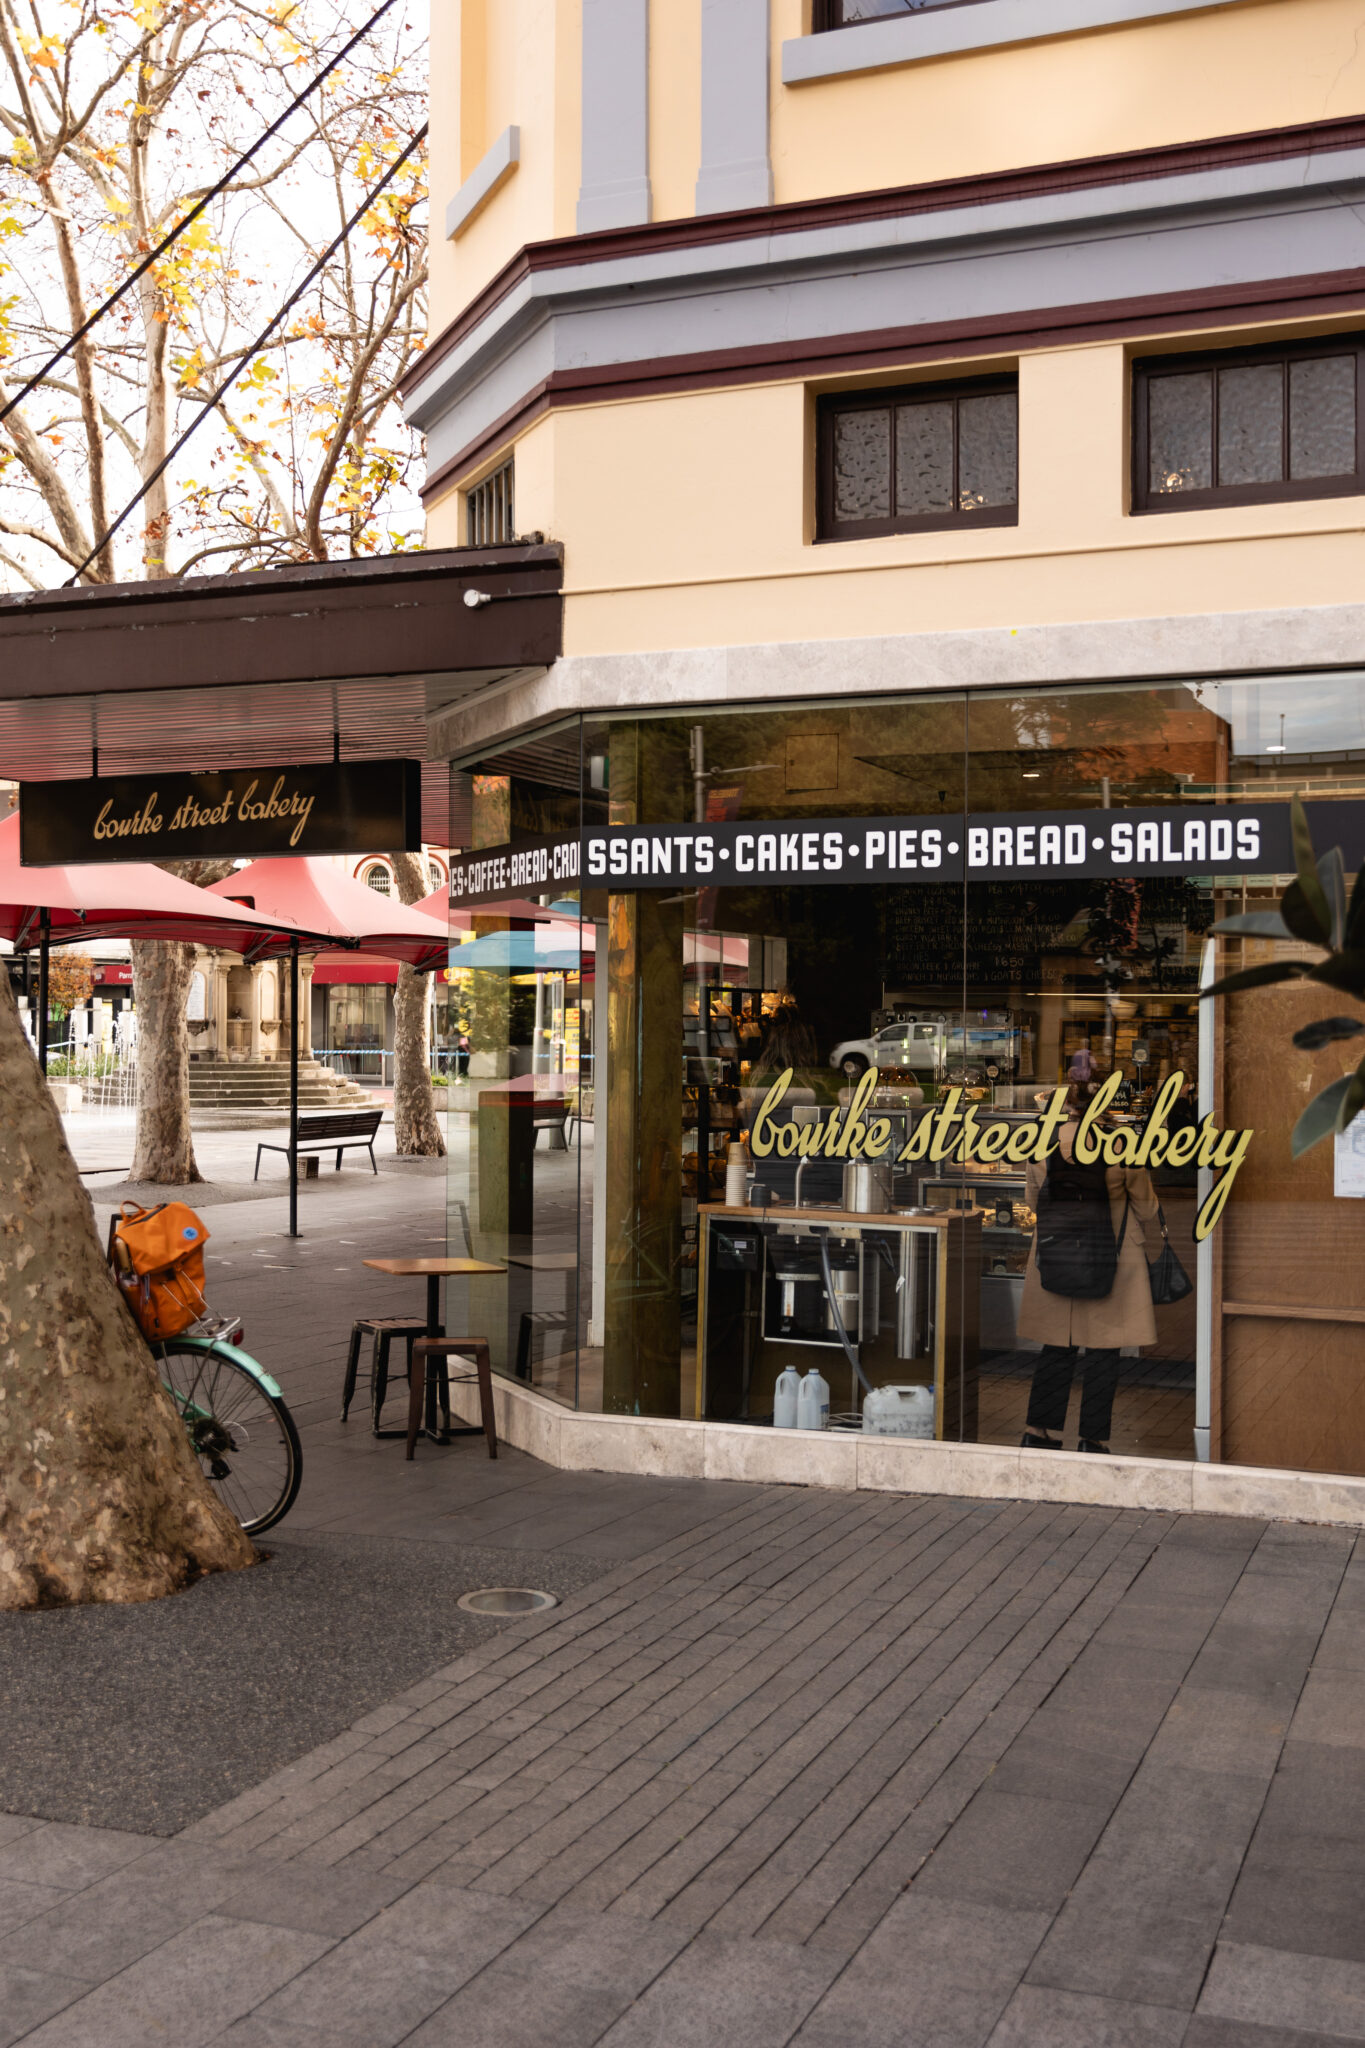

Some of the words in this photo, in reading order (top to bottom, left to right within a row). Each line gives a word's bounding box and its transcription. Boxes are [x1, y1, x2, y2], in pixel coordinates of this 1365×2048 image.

[94, 792, 163, 840] bourke
[168, 790, 234, 831] street
[238, 775, 315, 847] bakery
[468, 857, 506, 894] COFFEE
[511, 848, 548, 887] BREAD
[588, 835, 713, 876] SSANTS
[735, 831, 842, 873] CAKES
[865, 829, 942, 870] PIES
[968, 824, 1086, 867] BREAD
[1110, 818, 1260, 864] SALADS
[752, 1066, 891, 1159] bourke
[898, 1087, 1070, 1163] street
[1074, 1070, 1254, 1241] bakery
